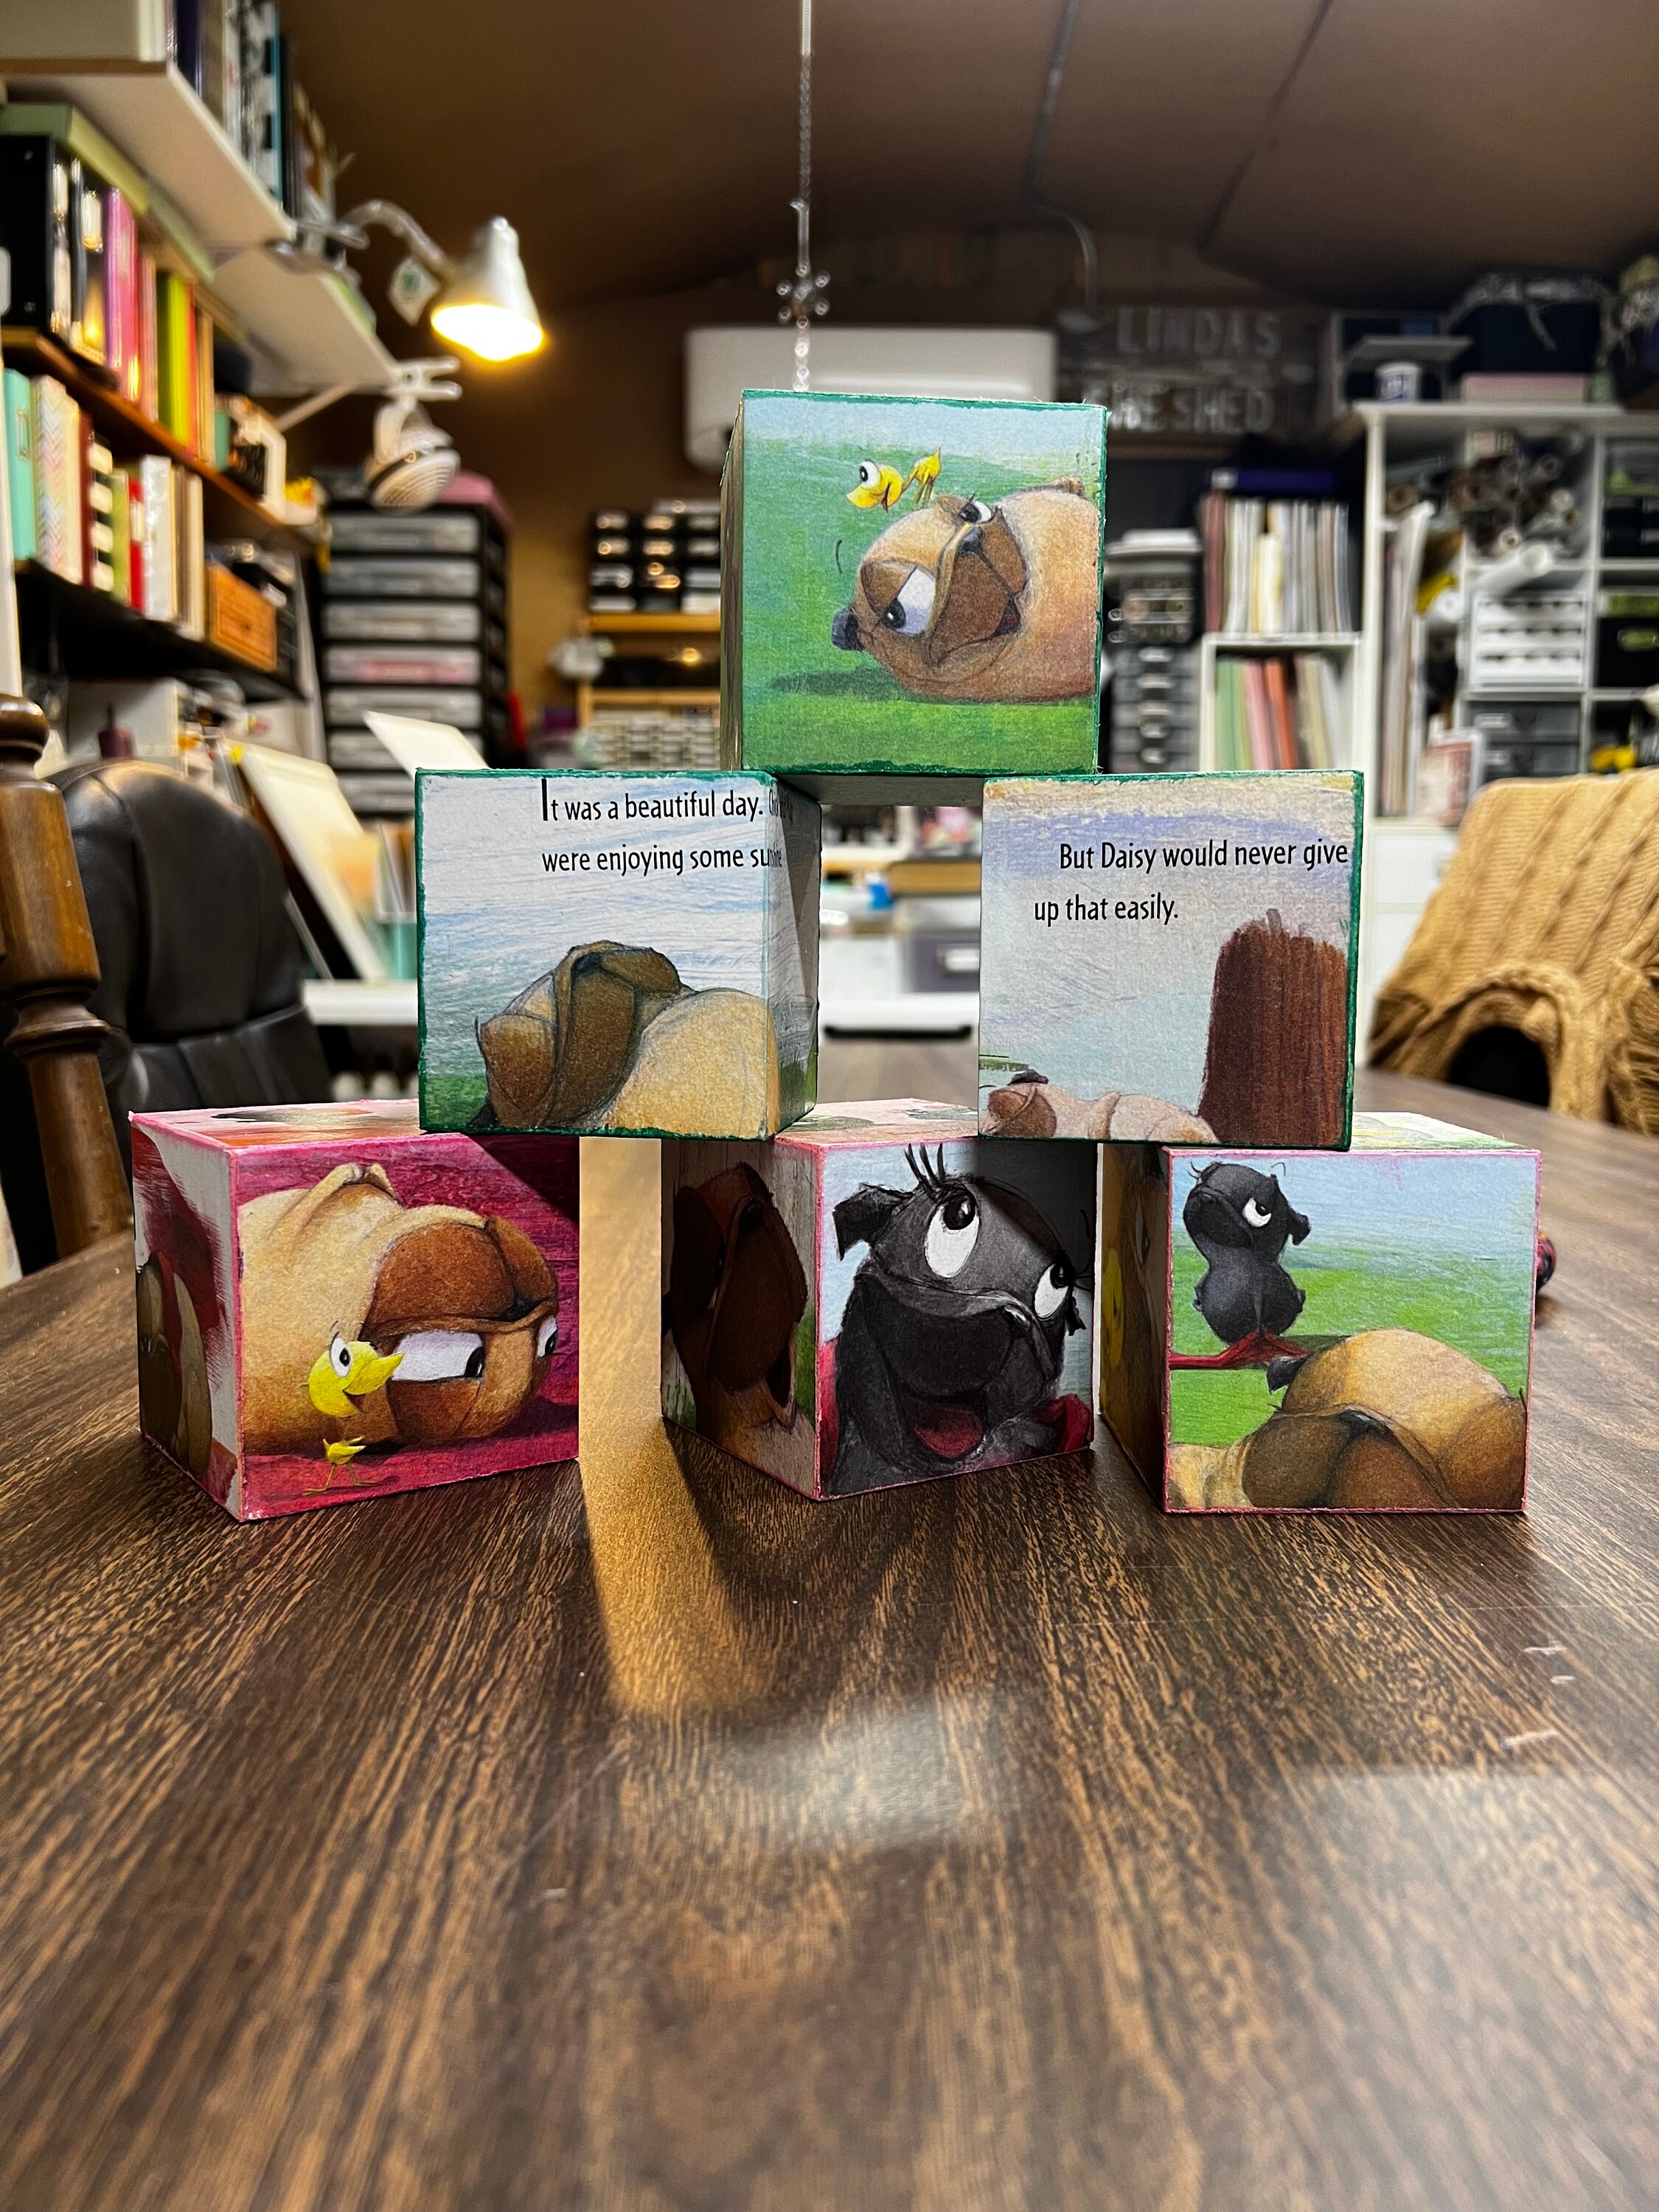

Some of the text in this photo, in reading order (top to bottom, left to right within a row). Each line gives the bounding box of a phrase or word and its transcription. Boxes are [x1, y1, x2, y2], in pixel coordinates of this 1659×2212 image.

[542, 778, 558, 821] It
[565, 801, 601, 820] was
[608, 801, 618, 819] a
[625, 790, 714, 818] beautiful
[723, 790, 762, 821] day.
[542, 853, 590, 872] were
[597, 844, 683, 876] enjoying
[690, 850, 743, 869] some
[1061, 838, 1347, 874] But Daisy would never give
[1035, 892, 1178, 927] up that easily.
